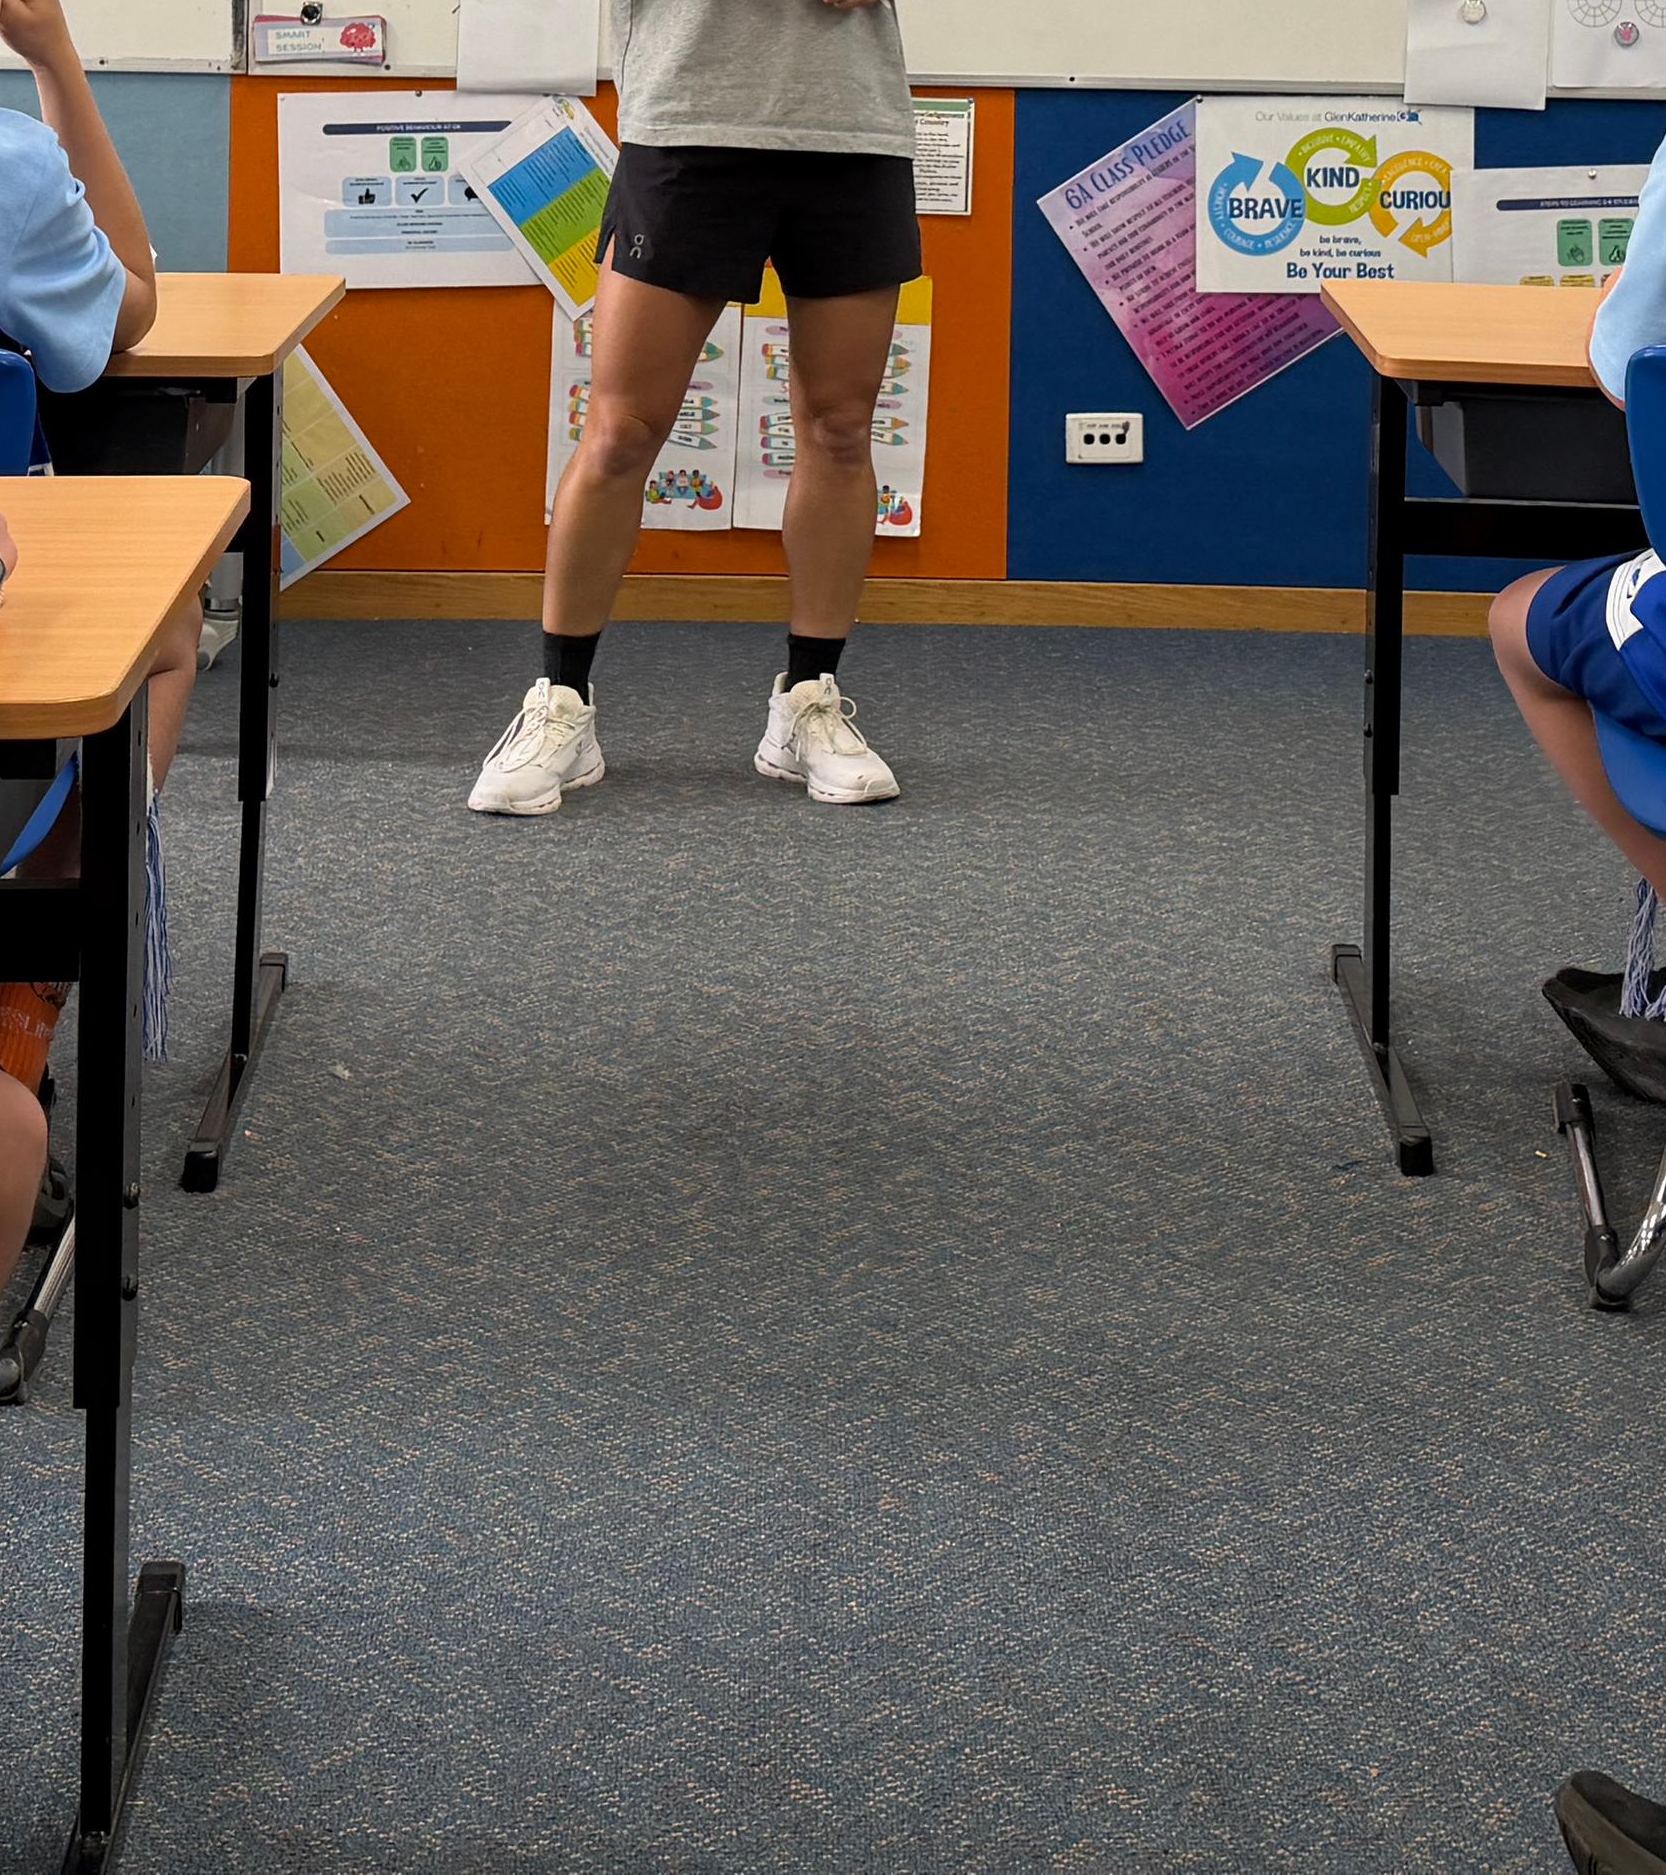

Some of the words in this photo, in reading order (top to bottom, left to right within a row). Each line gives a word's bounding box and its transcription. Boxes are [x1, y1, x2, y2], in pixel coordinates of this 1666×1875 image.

[275, 31, 310, 39] SMART
[276, 43, 322, 52] SESSION
[1306, 167, 1360, 188] KIND
[1064, 180, 1093, 210] 6A
[1380, 190, 1451, 209] CURIOU
[1228, 198, 1303, 219] BRAVE
[1320, 236, 1331, 244] be
[1333, 236, 1361, 244] brave,
[1300, 249, 1310, 257] be
[1313, 249, 1333, 257] kind,
[1336, 249, 1347, 257] be
[1349, 249, 1381, 257] curious
[1286, 263, 1307, 278] Be
[1312, 262, 1351, 278] Your
[1357, 262, 1394, 278] Best
